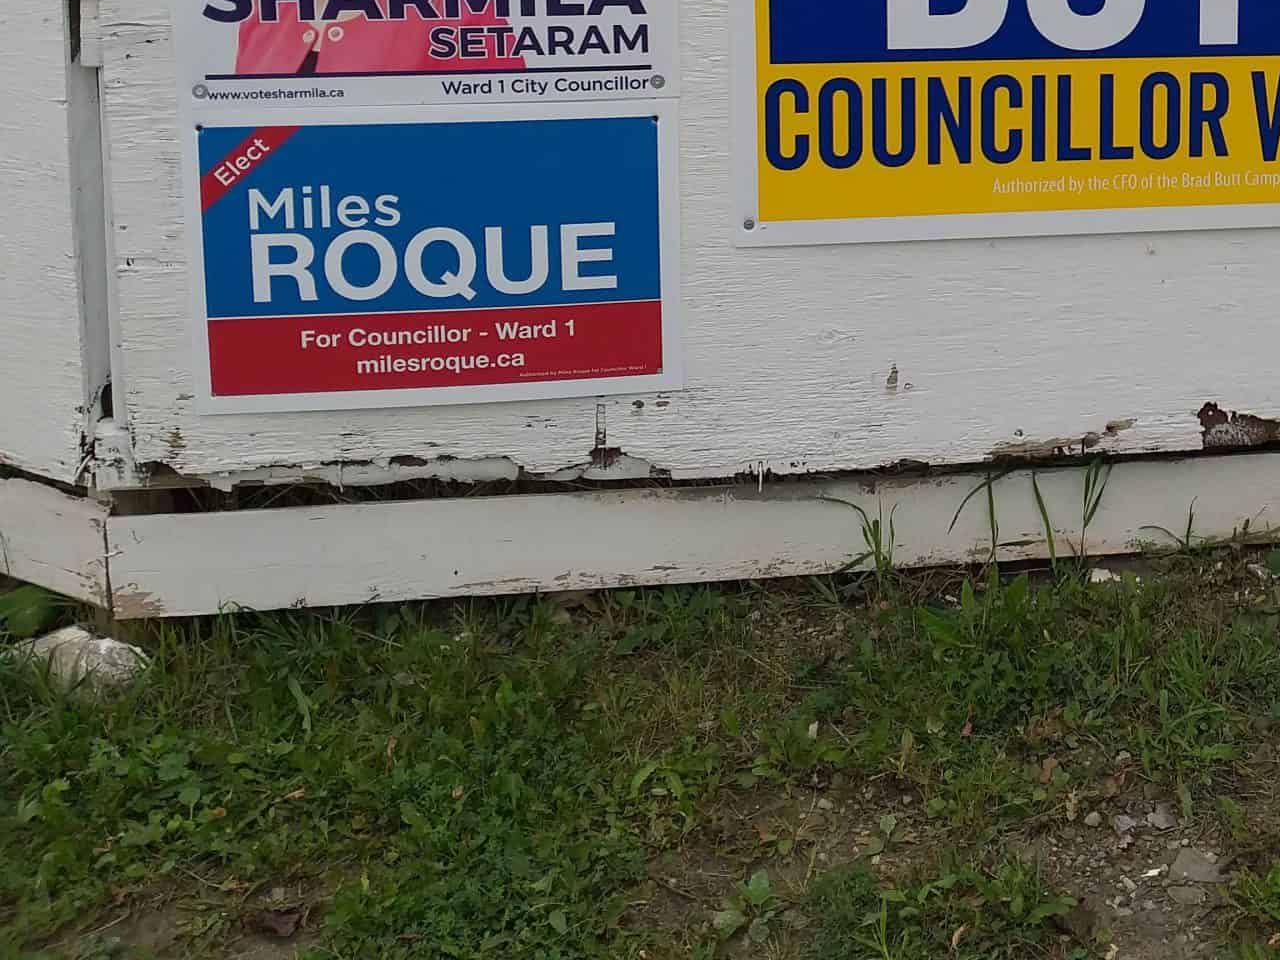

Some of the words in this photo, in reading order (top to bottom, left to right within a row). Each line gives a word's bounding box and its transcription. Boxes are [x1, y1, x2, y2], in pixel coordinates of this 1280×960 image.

[429, 23, 650, 59] SETARAM
[208, 87, 344, 101] www.votesharmila.ca
[442, 79, 492, 96] Ward
[498, 79, 505, 94] 1
[511, 78, 548, 97] City
[554, 76, 649, 92] Councillor
[764, 71, 1230, 171] COUNCILLOR
[213, 136, 270, 187] Elect
[992, 175, 1065, 193] Authorized
[1069, 176, 1084, 195] by
[1088, 175, 1109, 191] the
[1113, 174, 1137, 190] CFO
[1141, 173, 1153, 190] of
[1157, 173, 1178, 188] the
[1181, 172, 1210, 188] Brad
[1214, 171, 1241, 187] Butt
[247, 185, 401, 231] Miles
[250, 221, 618, 304] ROQUE
[301, 329, 342, 350] For
[348, 325, 470, 347] Councillor
[496, 320, 558, 342] Ward
[566, 319, 576, 337] 1
[356, 351, 526, 376] milesroque.ca
